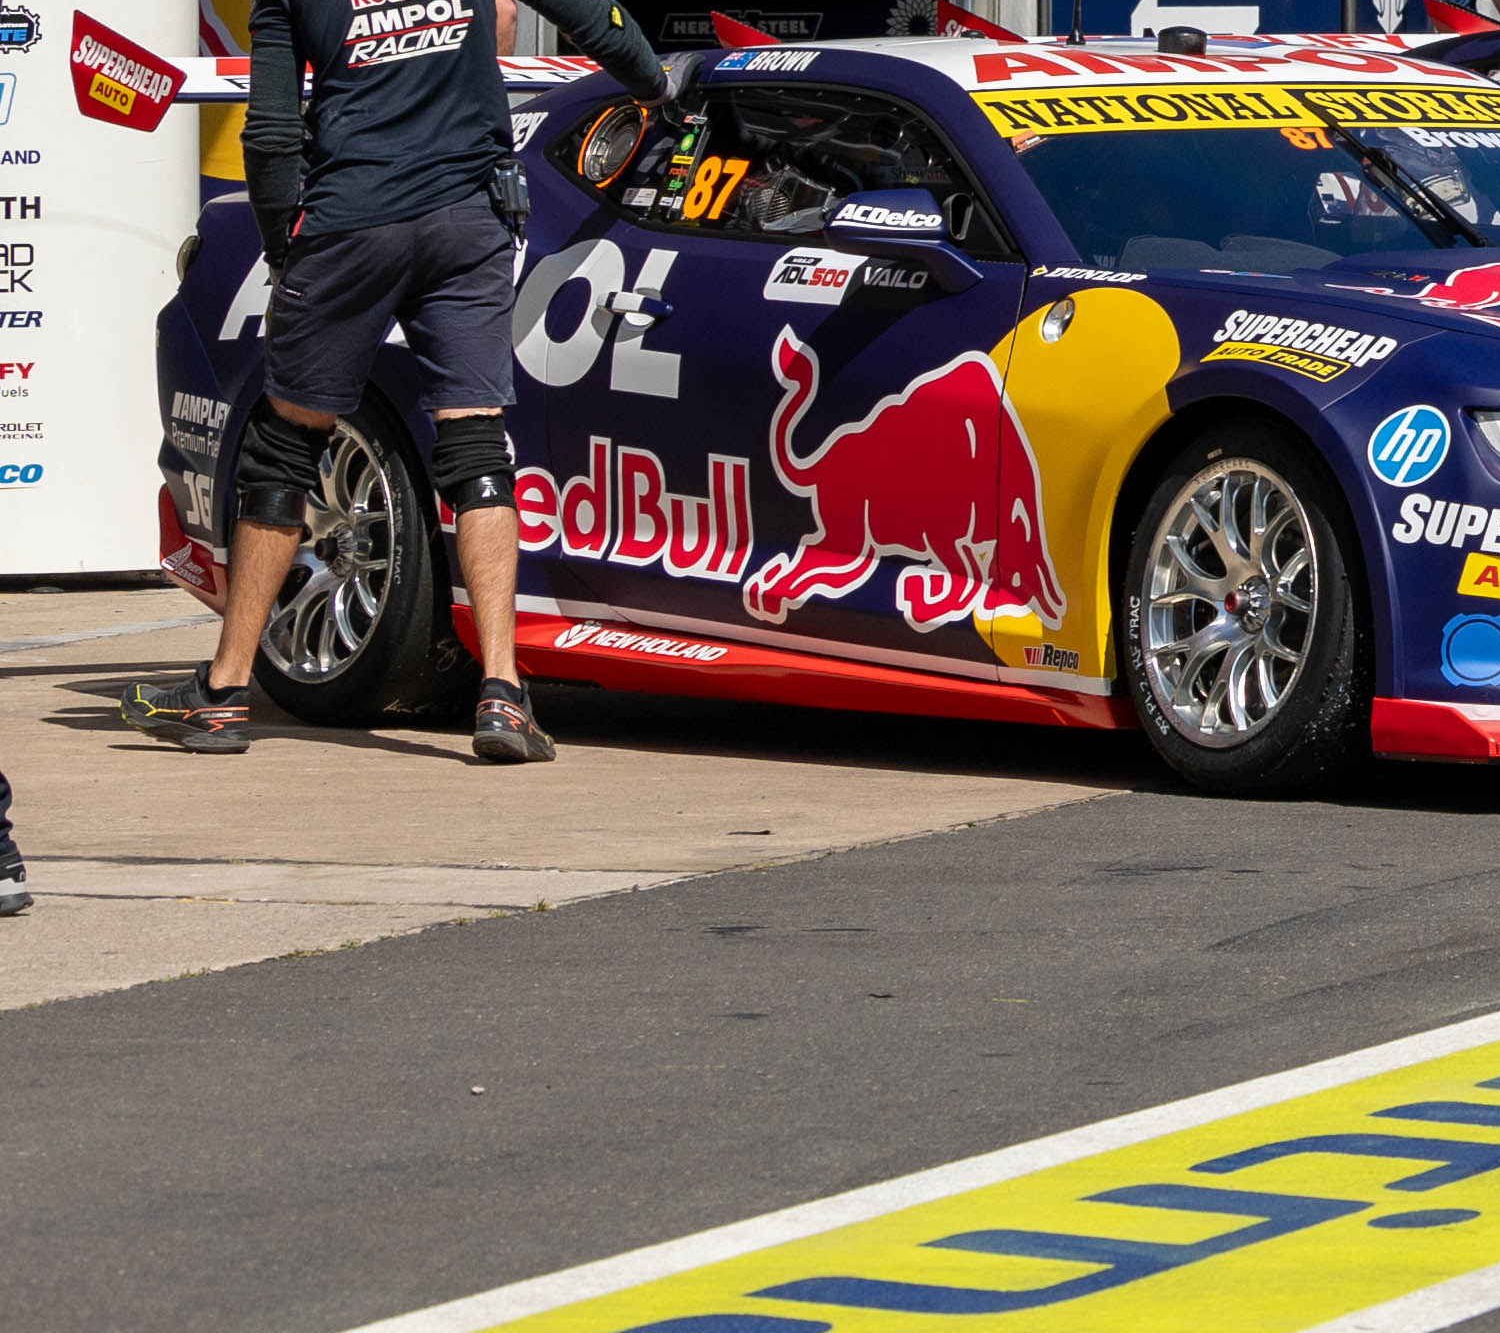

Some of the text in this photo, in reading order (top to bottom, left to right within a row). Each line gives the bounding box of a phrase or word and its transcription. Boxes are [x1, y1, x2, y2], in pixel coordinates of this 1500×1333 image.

[348, 22, 468, 65] RACING
[73, 34, 173, 105] SUPERCHEAP
[745, 50, 821, 73] BROWN
[974, 49, 1480, 85] AMPOL
[94, 79, 130, 108] AUTO
[985, 93, 1301, 129] NATIONAL
[1281, 127, 1335, 149] 87
[682, 156, 750, 221] 87
[835, 202, 943, 229] ACDelco
[773, 265, 849, 289] ADL500
[863, 265, 929, 290] VAILO
[1046, 267, 1149, 284] DUNLOP
[1212, 309, 1399, 368] SUPERCHEAP
[1218, 346, 1334, 381] AUTO TRADE
[181, 392, 231, 433] AMPLIFY
[1385, 407, 1435, 484] hp
[596, 629, 729, 663] NEW HOLLAND
[1040, 643, 1079, 672] Repco
